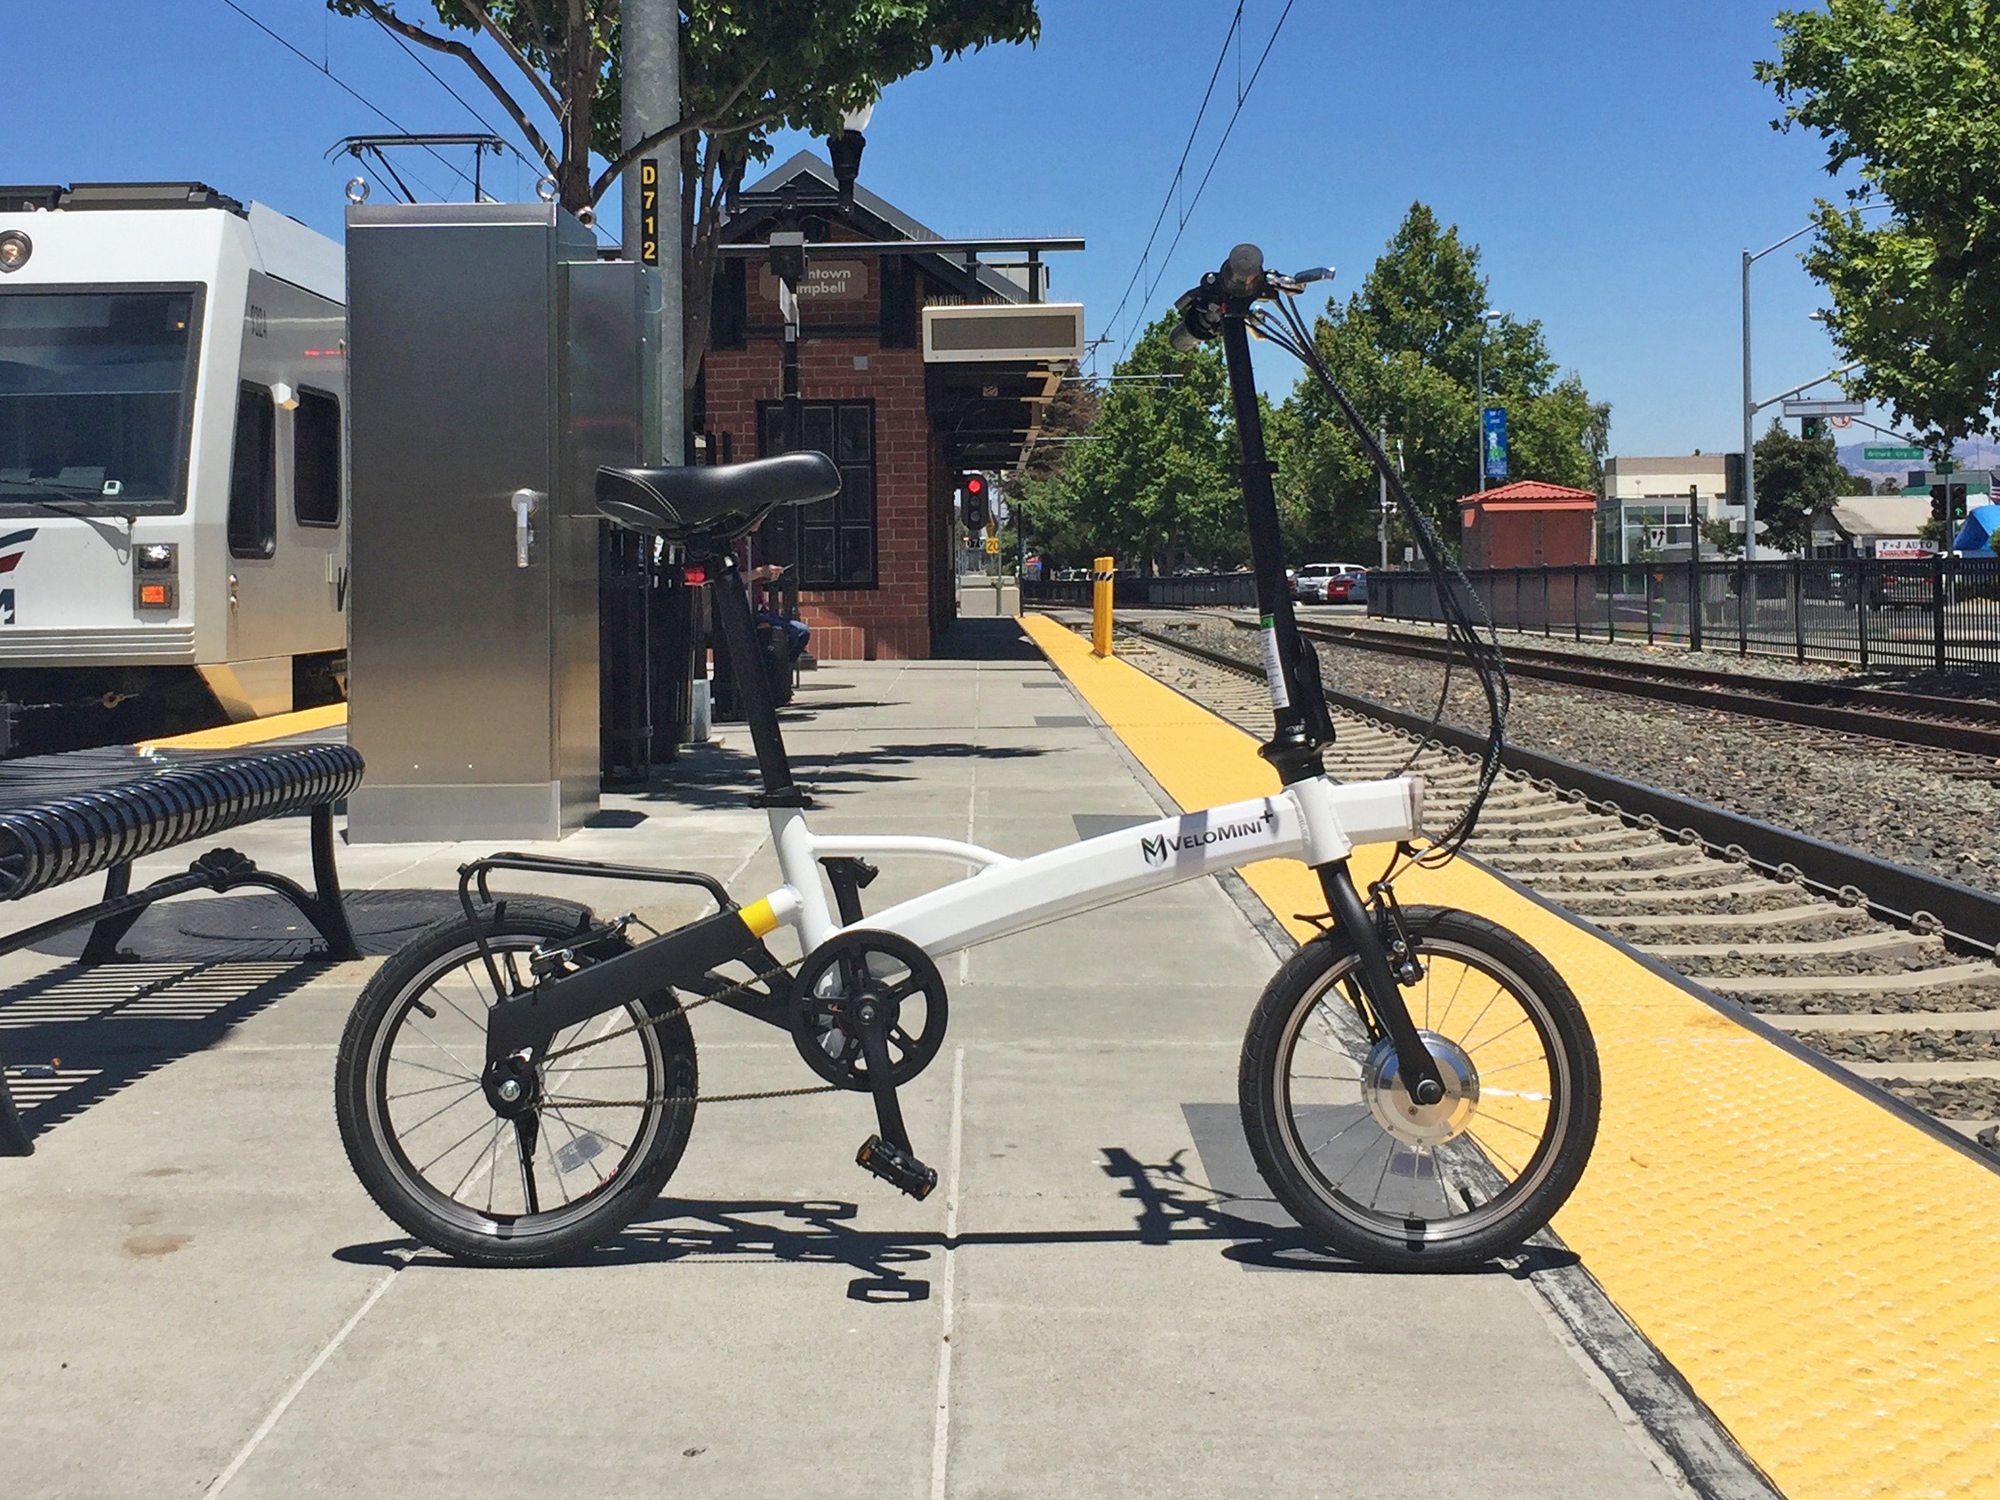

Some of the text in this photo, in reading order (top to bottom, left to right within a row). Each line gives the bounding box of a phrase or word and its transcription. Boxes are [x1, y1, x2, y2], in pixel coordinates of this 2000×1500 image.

[643, 166, 656, 259] D712
[808, 269, 851, 279] ntown
[796, 281, 846, 296] mpbell
[987, 540, 999, 551] 20
[1906, 541, 1933, 549] AUTO
